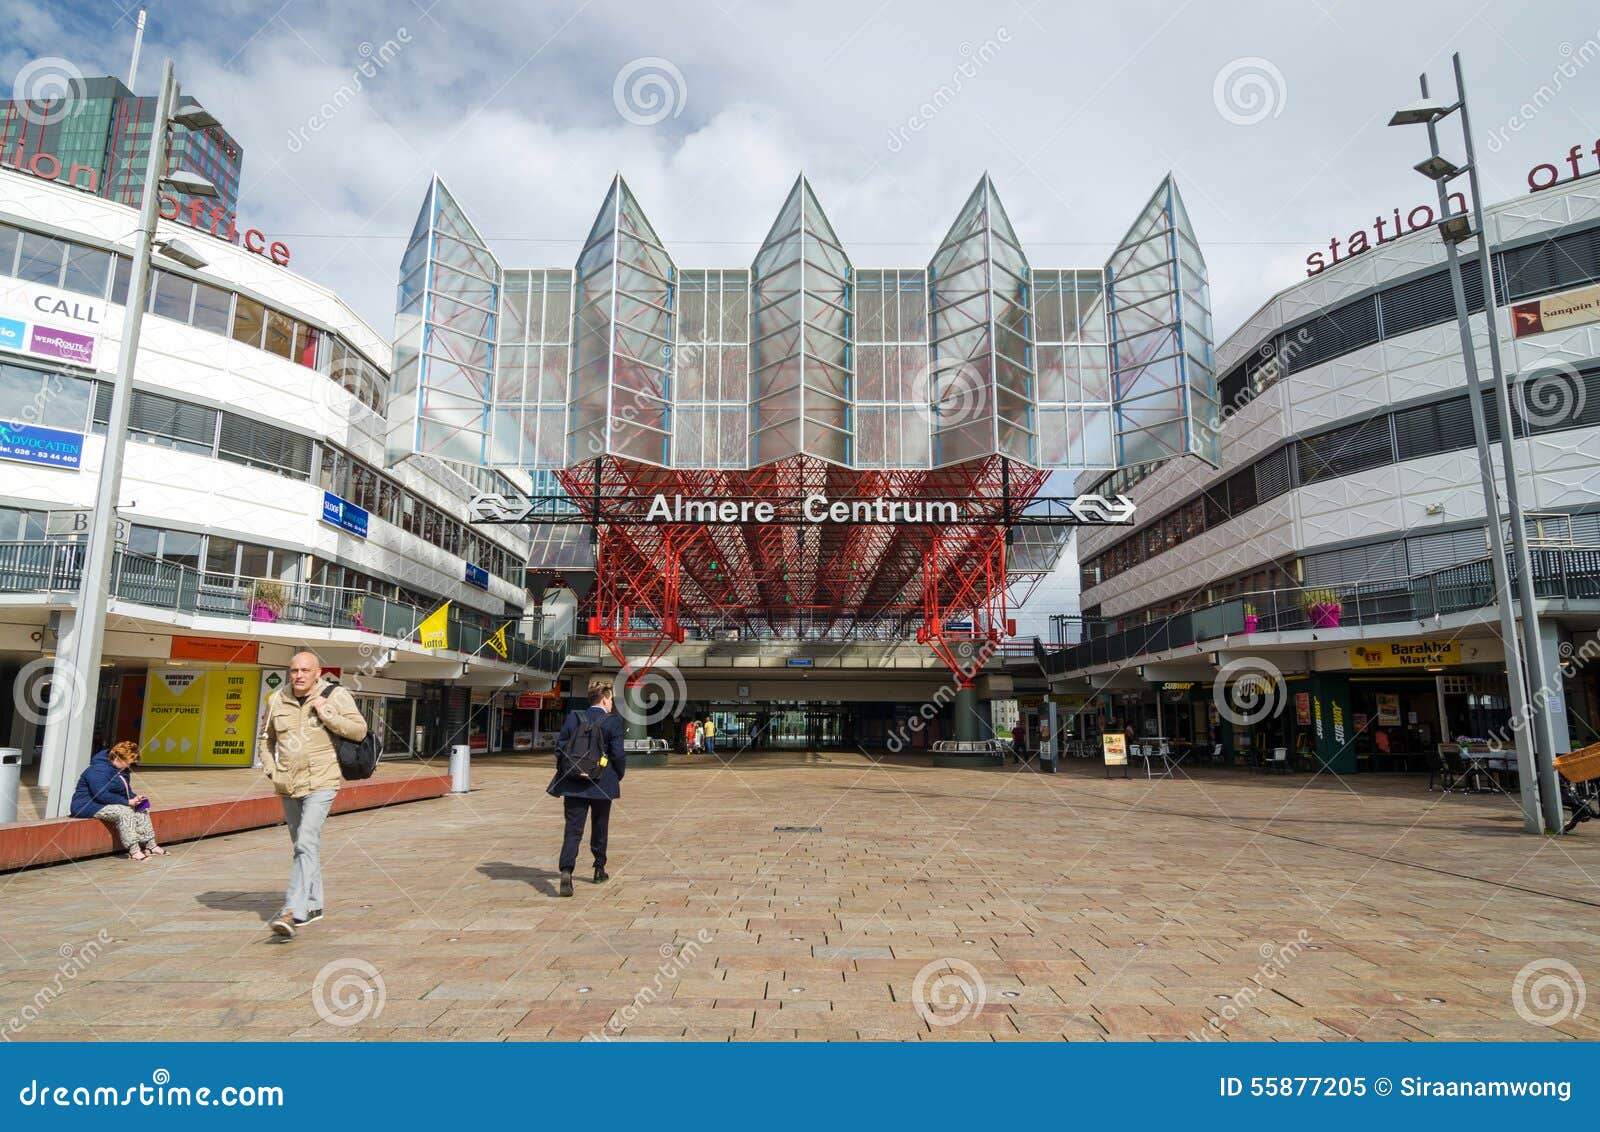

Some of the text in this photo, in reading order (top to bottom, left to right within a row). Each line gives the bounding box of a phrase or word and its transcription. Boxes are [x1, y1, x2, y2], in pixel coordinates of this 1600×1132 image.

[157, 194, 291, 266] office
[1306, 190, 1469, 277] station
[1543, 303, 1592, 318] Sanquin
[646, 494, 959, 522] Almere Centrum
[1391, 642, 1451, 655] Barakha
[1162, 682, 1194, 690] SUBWAY
[1236, 676, 1278, 697] SUBWAY
[1313, 696, 1323, 740] SUBWAY
[1332, 701, 1345, 745] SUBWAY
